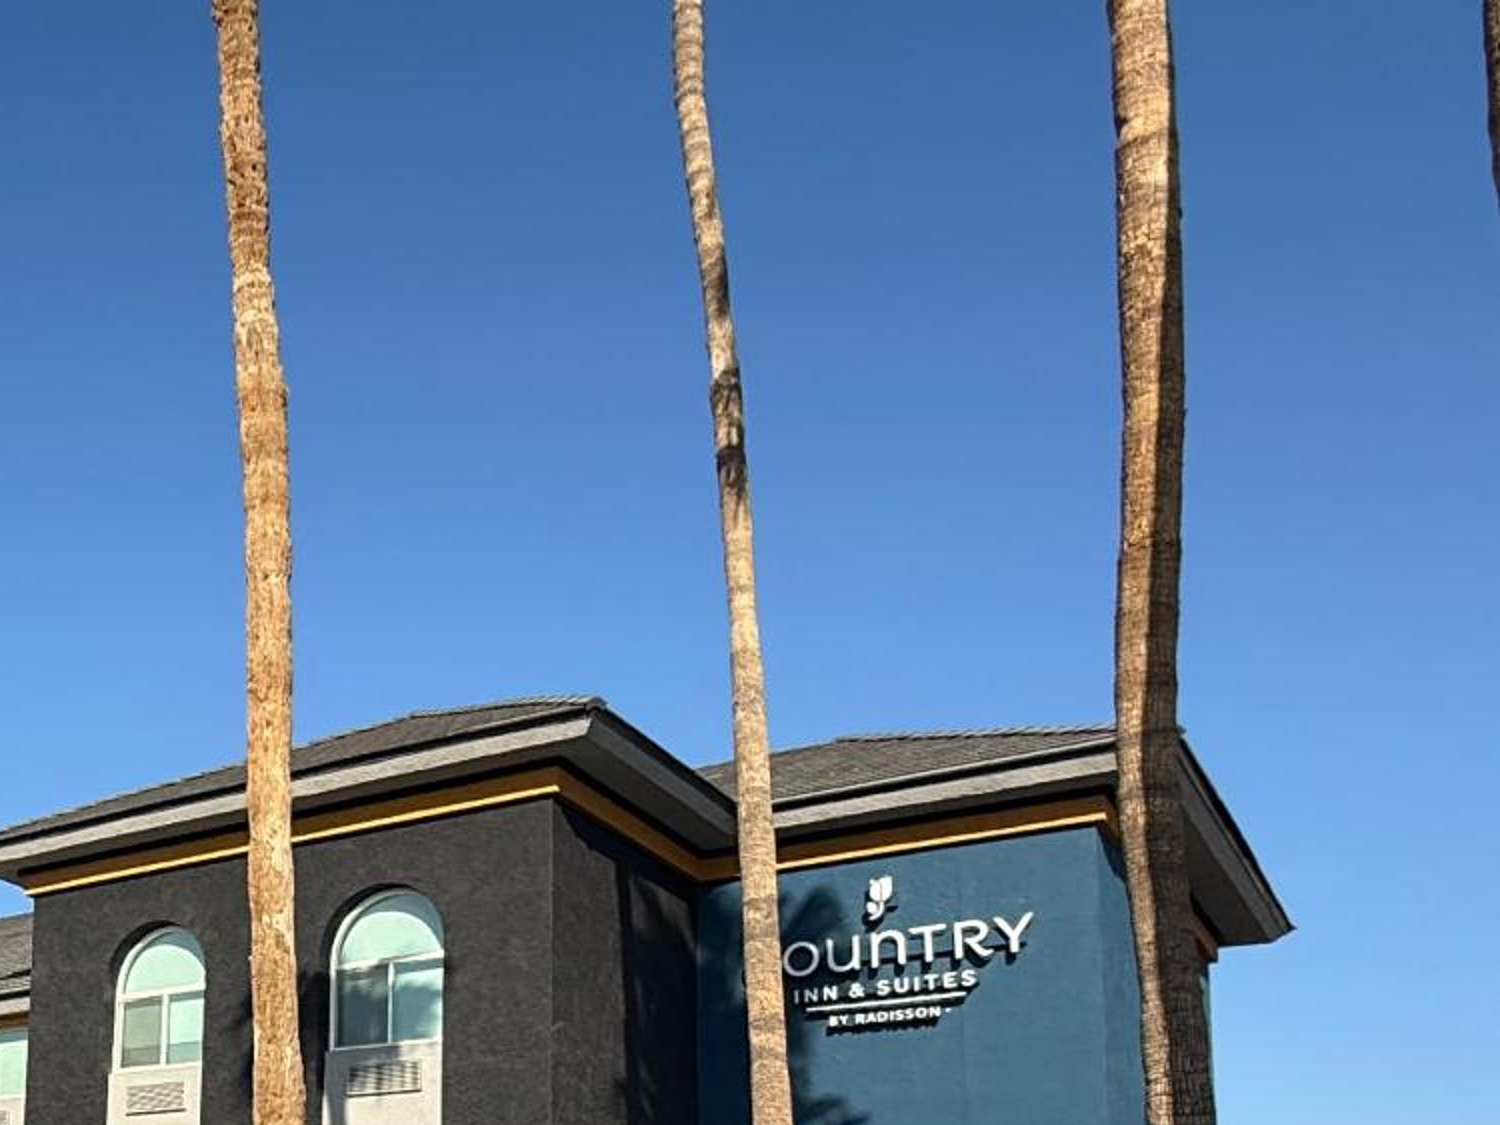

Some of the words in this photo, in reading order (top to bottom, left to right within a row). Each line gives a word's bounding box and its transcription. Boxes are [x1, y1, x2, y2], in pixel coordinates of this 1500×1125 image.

[781, 910, 1035, 978] OUNTRY
[793, 984, 839, 1005] INN
[847, 981, 866, 1000] &
[876, 968, 978, 997] SUITES
[828, 1014, 850, 1027] BY
[854, 1005, 943, 1026] RADISSON
